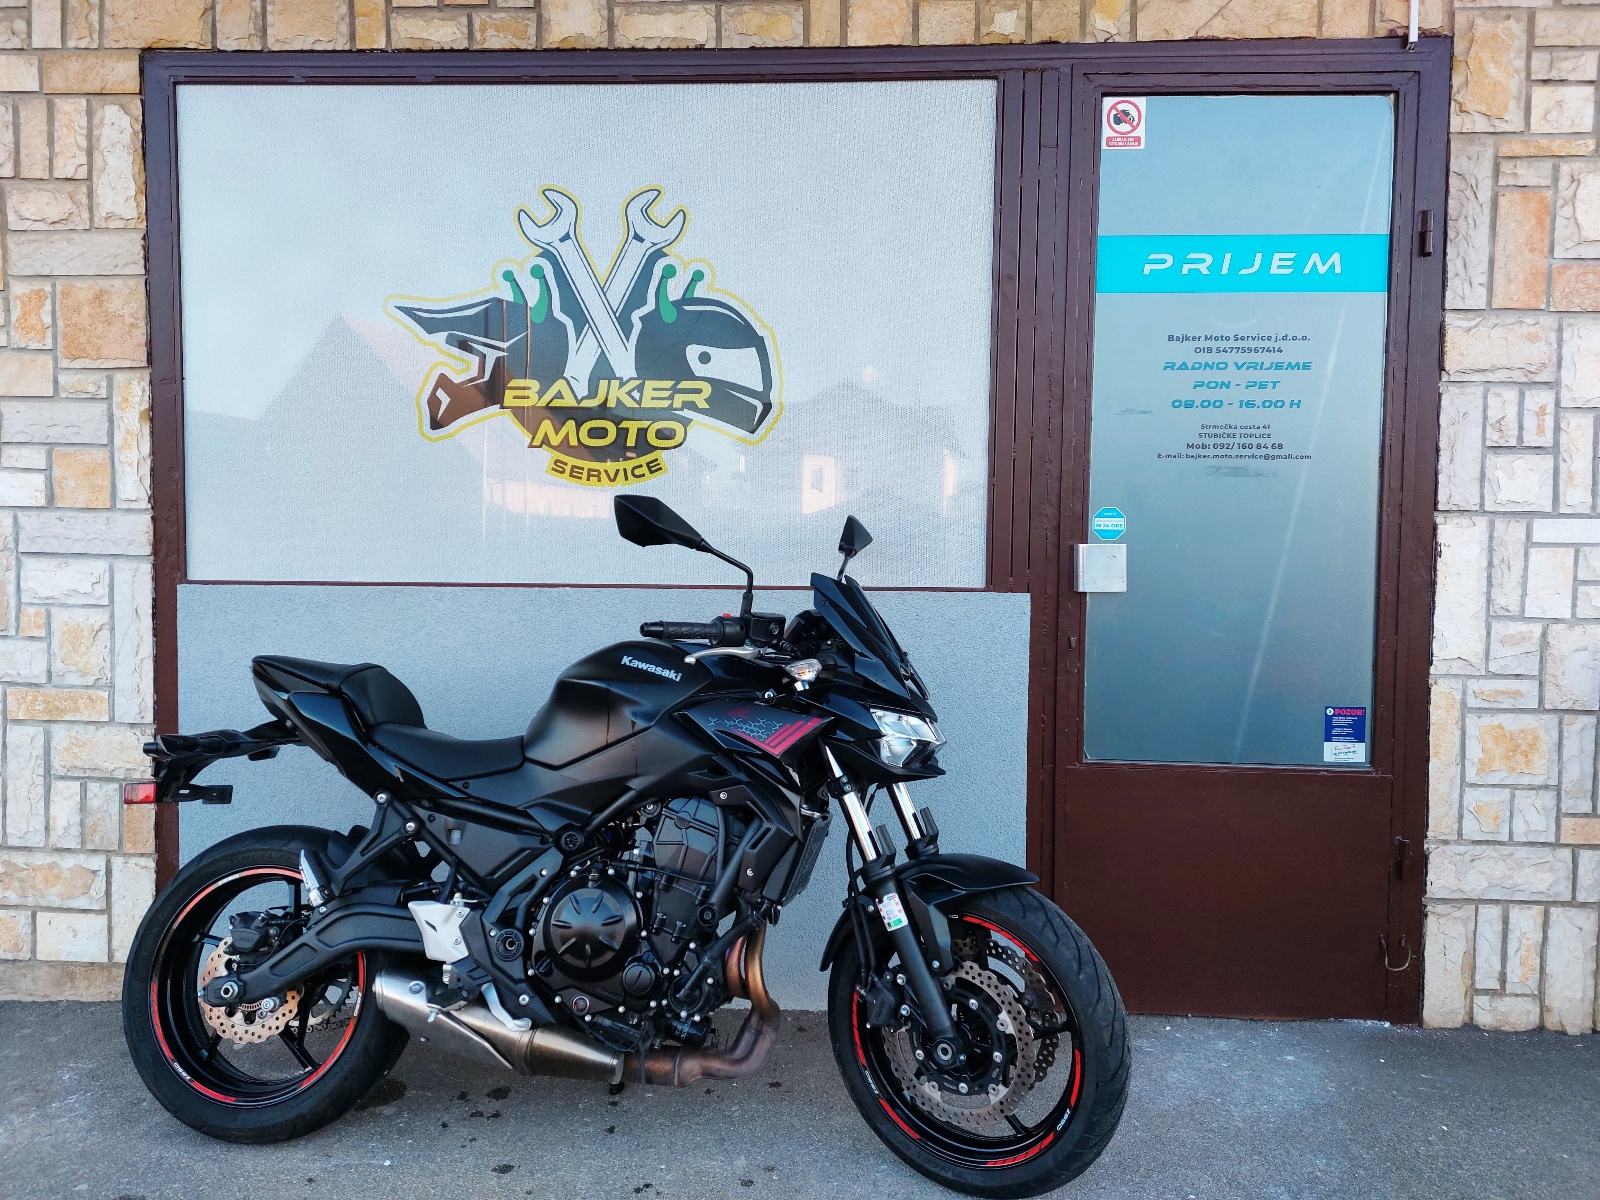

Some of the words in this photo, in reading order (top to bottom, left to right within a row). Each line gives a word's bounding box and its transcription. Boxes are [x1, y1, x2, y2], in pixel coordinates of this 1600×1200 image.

[1142, 252, 1343, 275] PRIJEM
[1167, 334, 1202, 344] Bajker
[1204, 334, 1231, 342] Moto
[1233, 333, 1273, 342] Service
[1273, 333, 1311, 343] j.d.o.o.
[1194, 346, 1213, 354] OIB
[1162, 361, 1229, 371] RADNO
[1233, 361, 1313, 371] VRIJEME
[1192, 380, 1232, 390] PON
[1244, 380, 1281, 390] PET
[502, 378, 713, 409] BAJKER
[1171, 399, 1224, 409] 08.00
[1238, 399, 1286, 409] 16.00
[1289, 399, 1302, 409] H
[531, 418, 686, 448] MOTO
[1198, 431, 1237, 439] STUBIČKE
[1186, 442, 1211, 450] Mob:
[1255, 442, 1269, 450] 84
[1270, 442, 1284, 450] 68
[550, 457, 663, 483] SERVICE
[620, 655, 682, 682] Kawasaki
